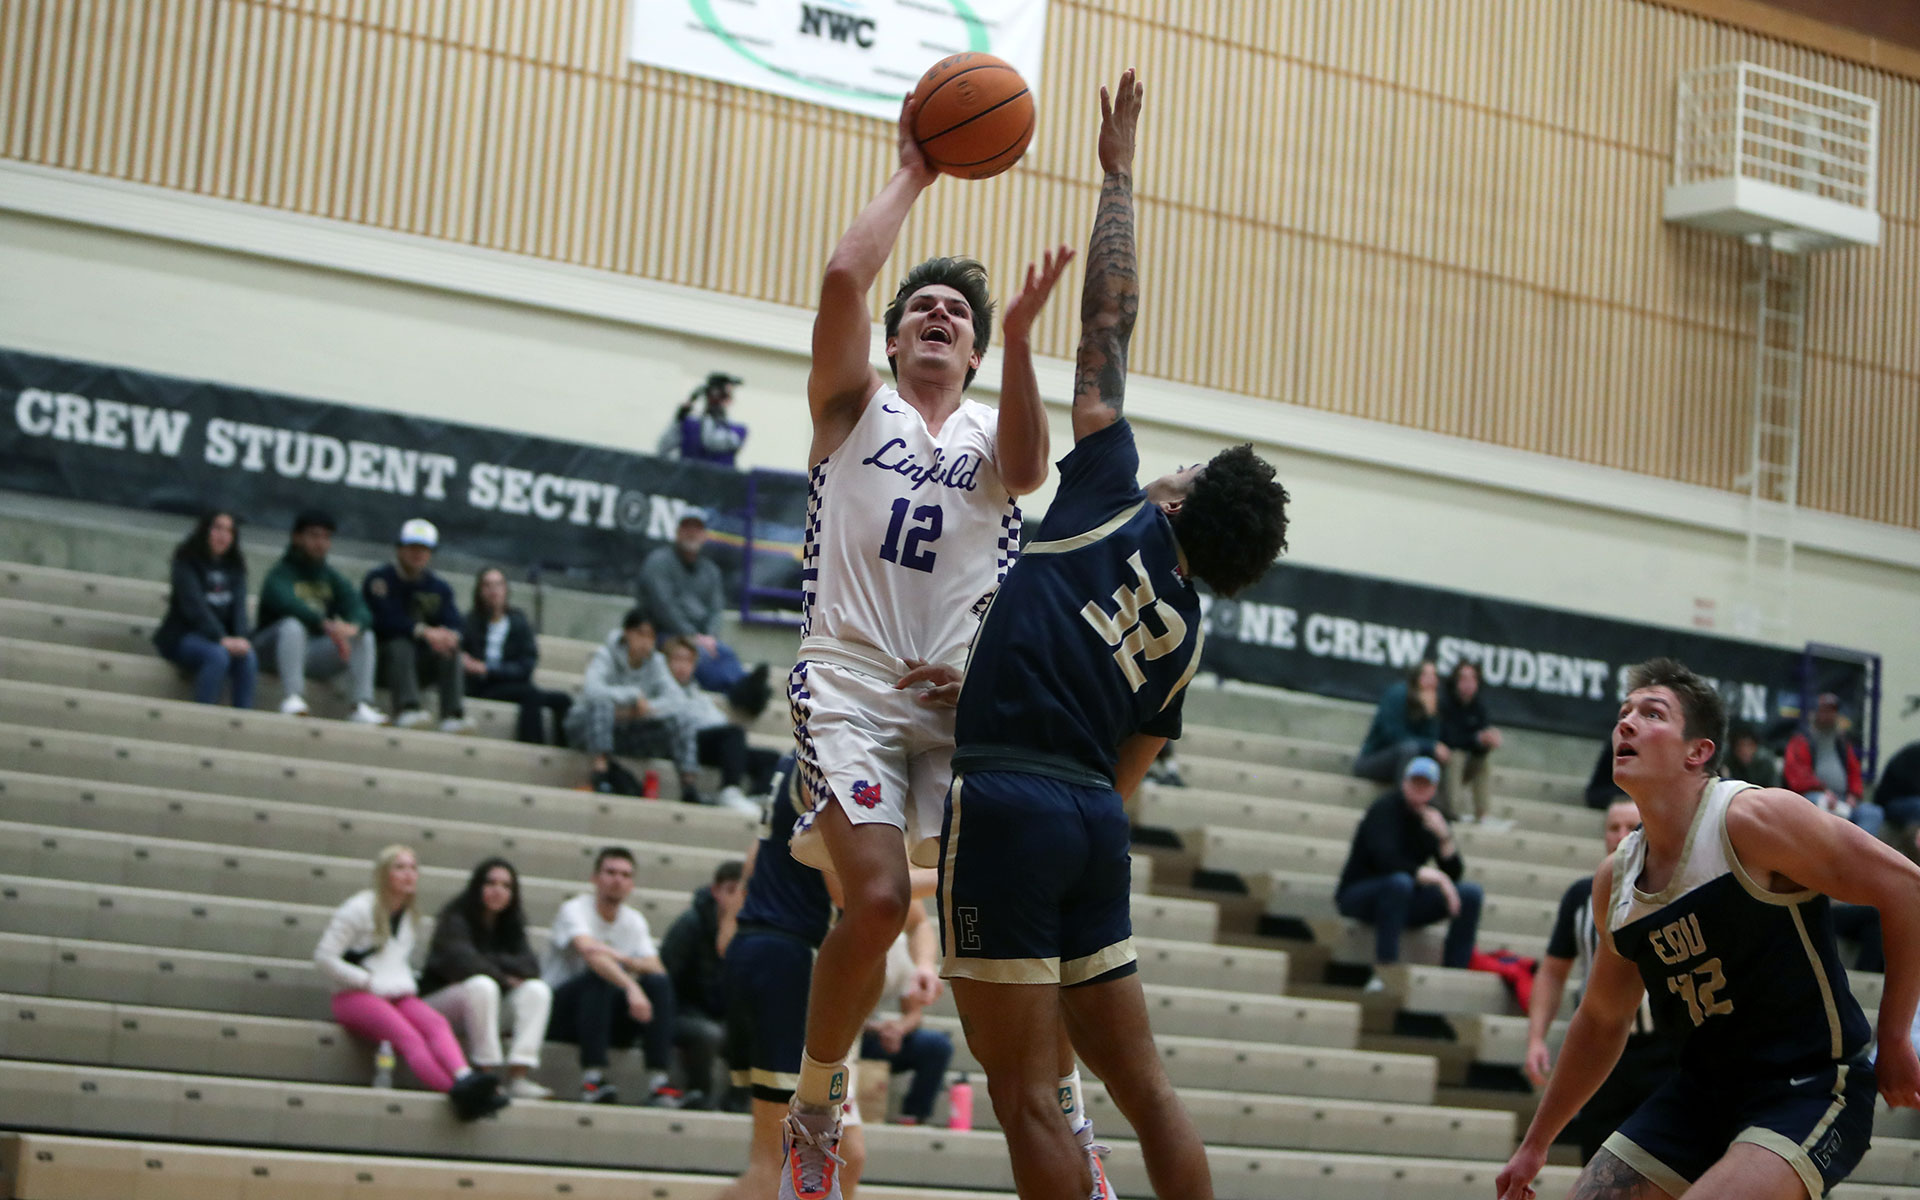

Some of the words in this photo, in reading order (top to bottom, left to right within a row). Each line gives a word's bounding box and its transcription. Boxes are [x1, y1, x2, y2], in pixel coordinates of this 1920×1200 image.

[800, 4, 876, 48] NWC
[15, 387, 190, 457] CREW
[204, 417, 457, 500] STUDENT
[879, 497, 943, 573] 12
[1080, 550, 1187, 693] 32
[1304, 613, 1429, 670] CREW
[958, 906, 981, 950] E
[1667, 957, 1734, 1027] 42
